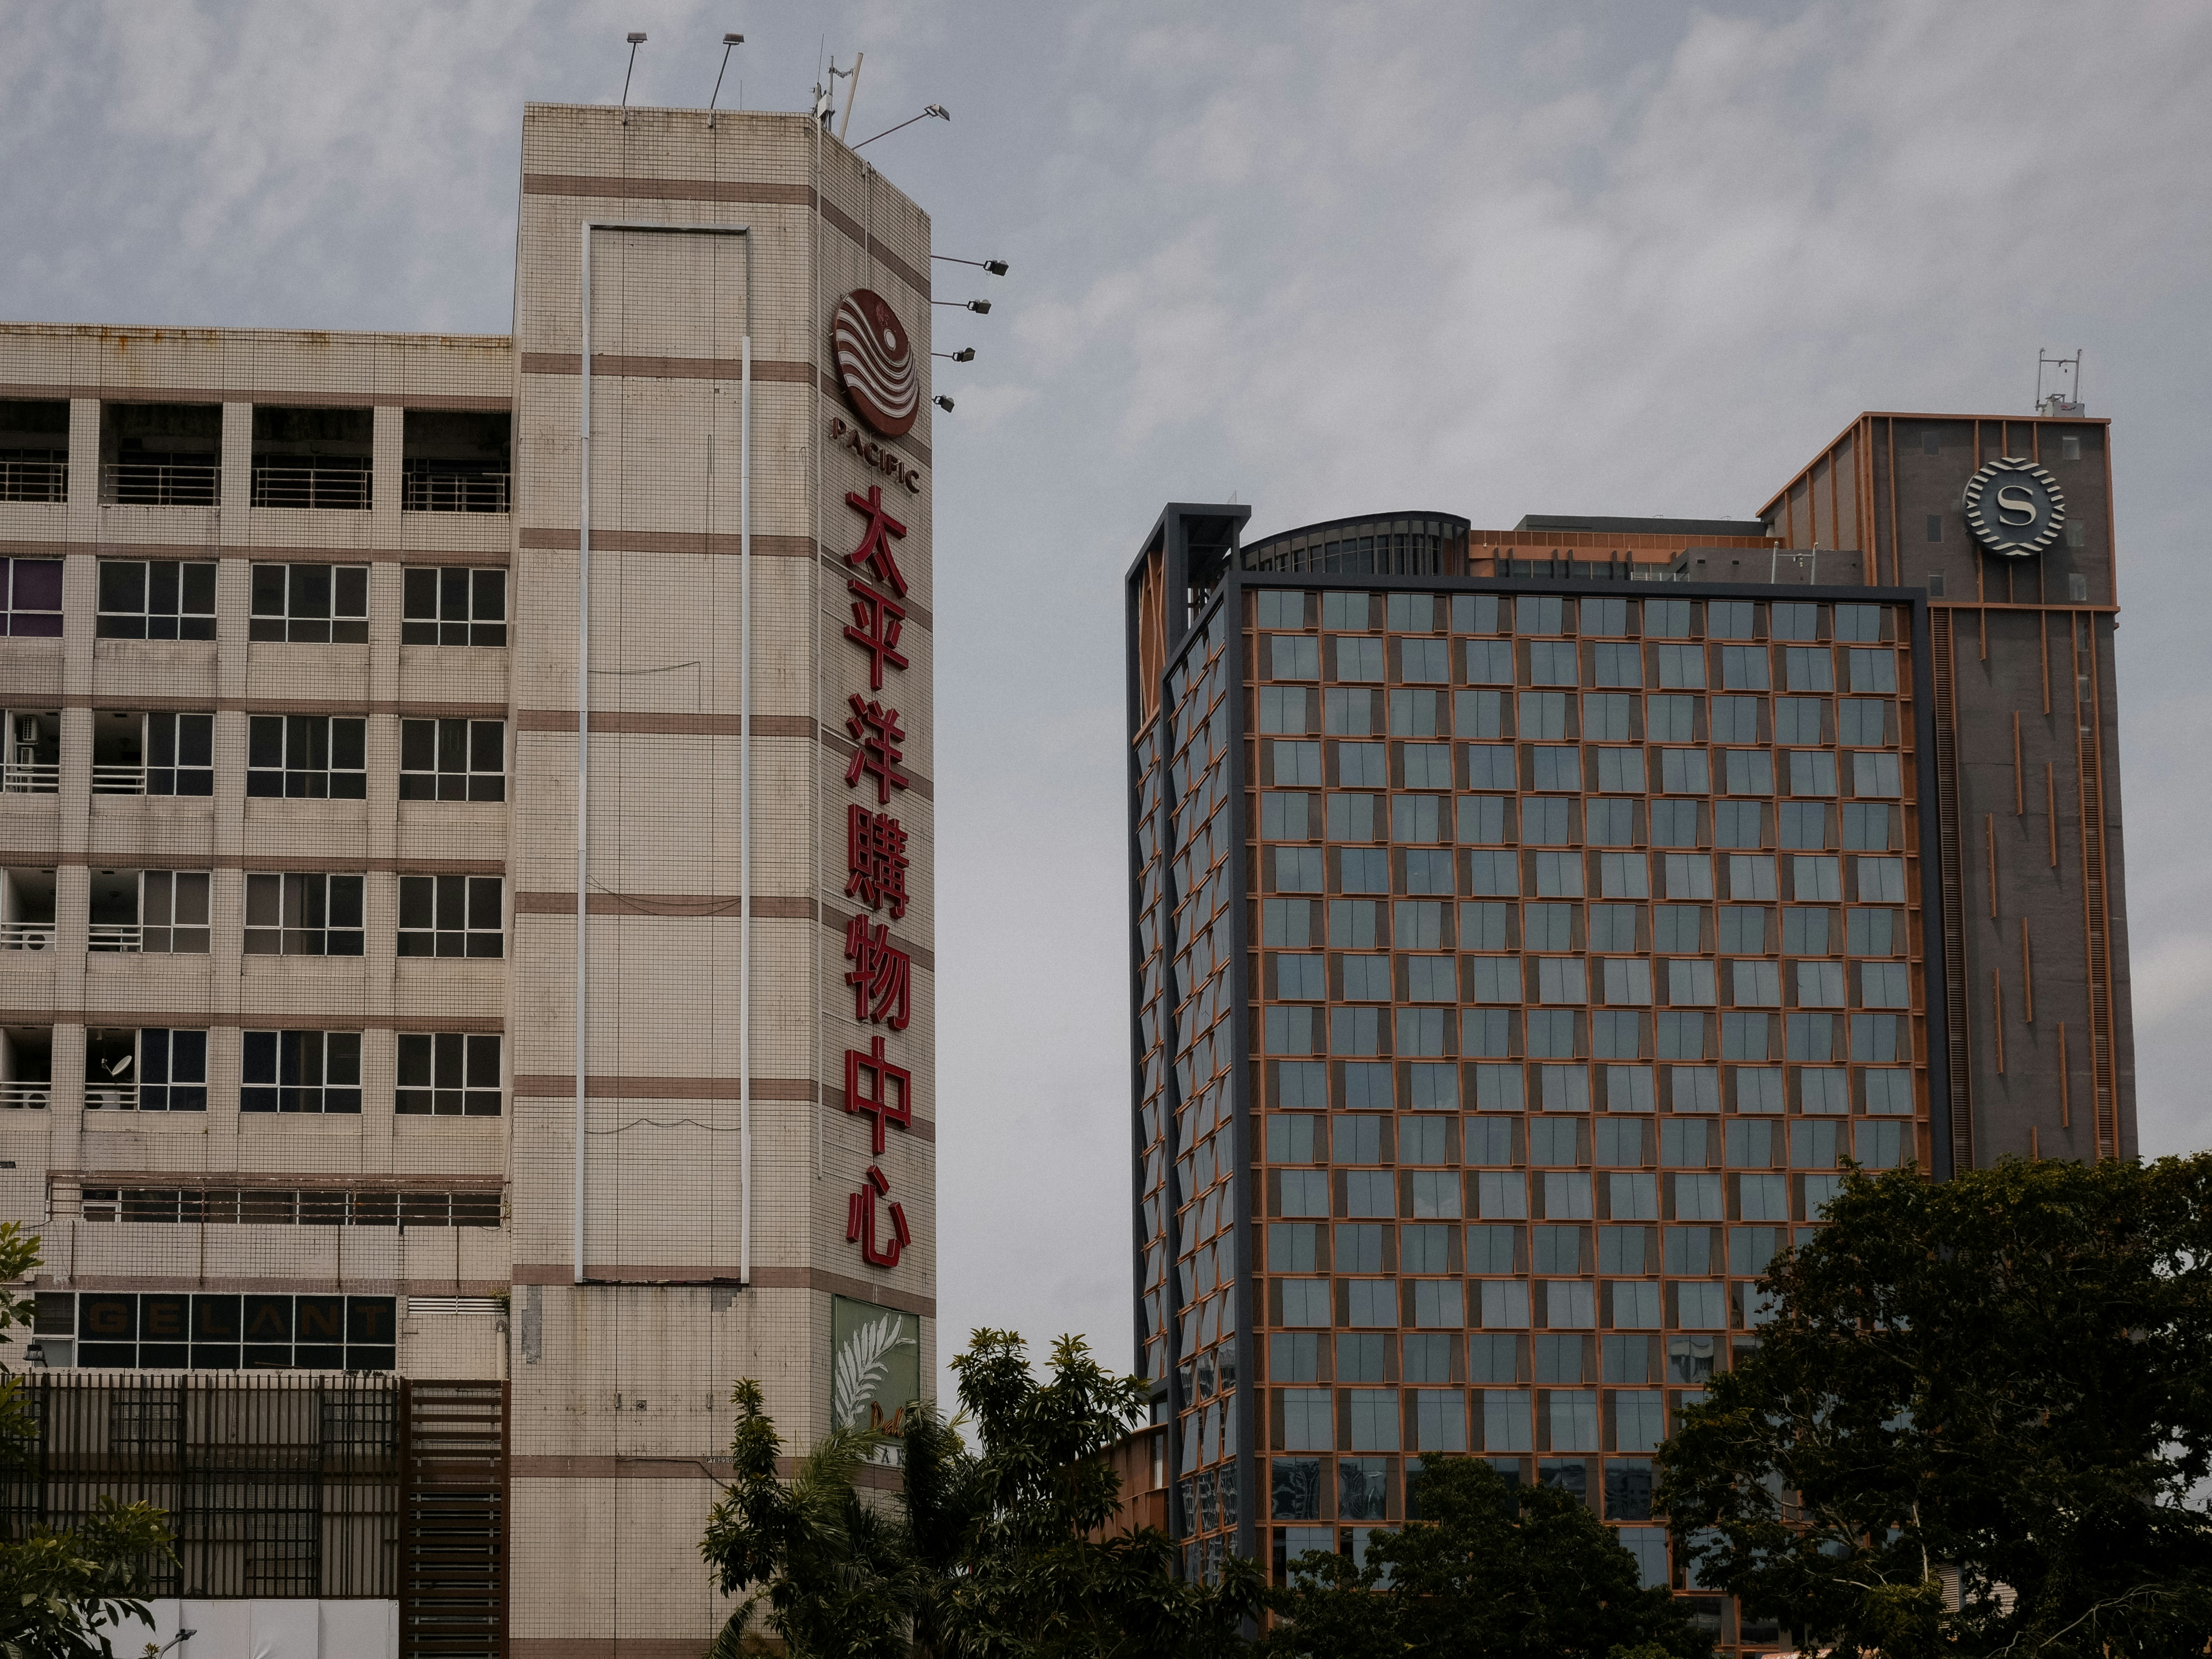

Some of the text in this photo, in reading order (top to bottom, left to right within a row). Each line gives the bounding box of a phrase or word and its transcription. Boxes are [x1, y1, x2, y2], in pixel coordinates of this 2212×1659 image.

[832, 417, 920, 494] PACIFIC
[1997, 485, 2036, 526] S
[844, 485, 911, 1268] 太平洋購物中心
[90, 1303, 387, 1336] GELANT
